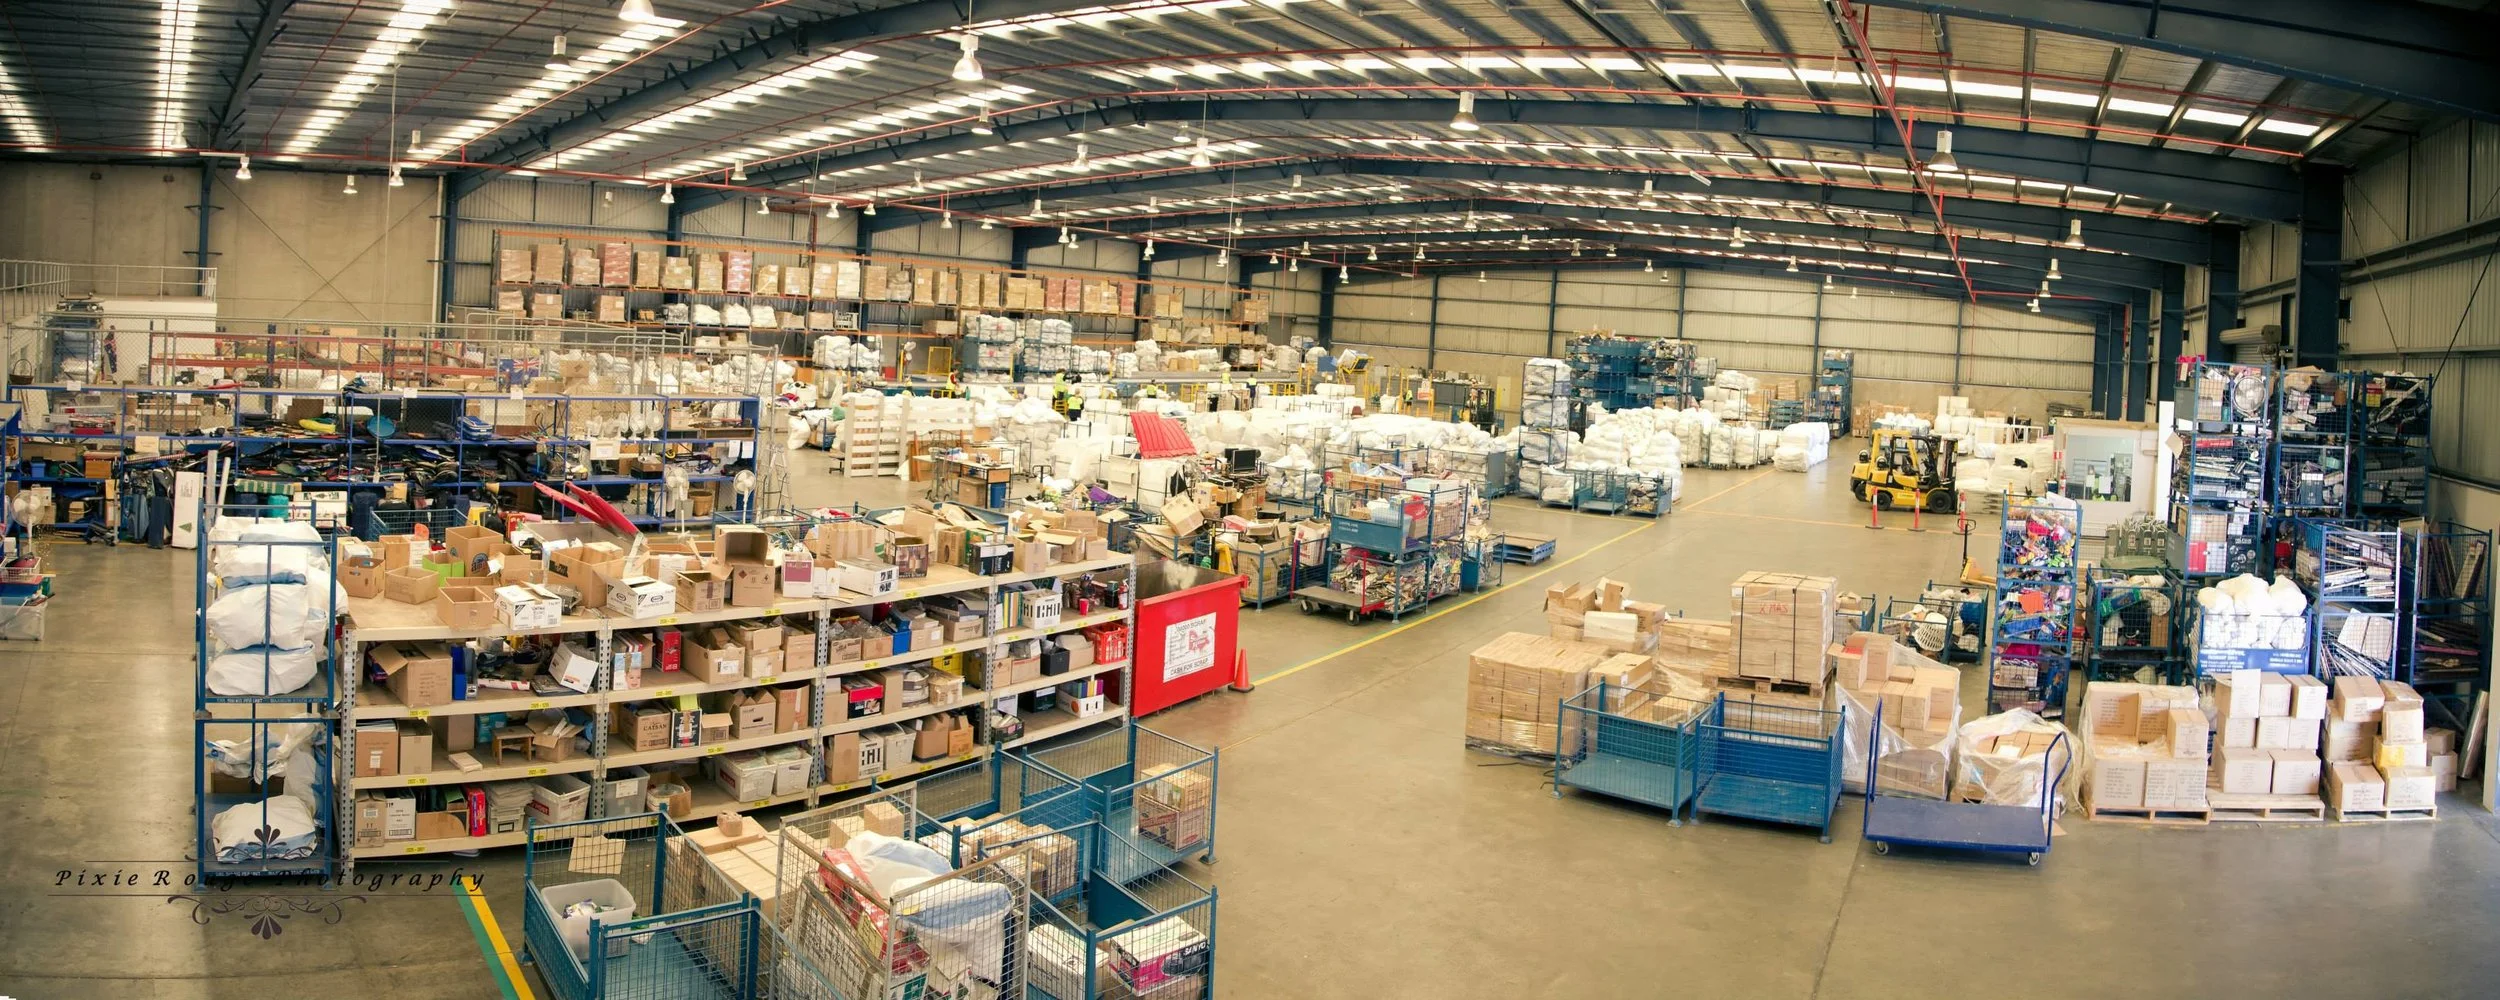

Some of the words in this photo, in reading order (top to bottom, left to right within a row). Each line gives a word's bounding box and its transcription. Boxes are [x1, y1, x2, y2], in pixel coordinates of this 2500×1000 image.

[1170, 667, 1183, 676] CASH
[1183, 663, 1193, 671] FOR
[643, 723, 668, 732] CATSAN
[1182, 941, 1207, 957] SANYO
